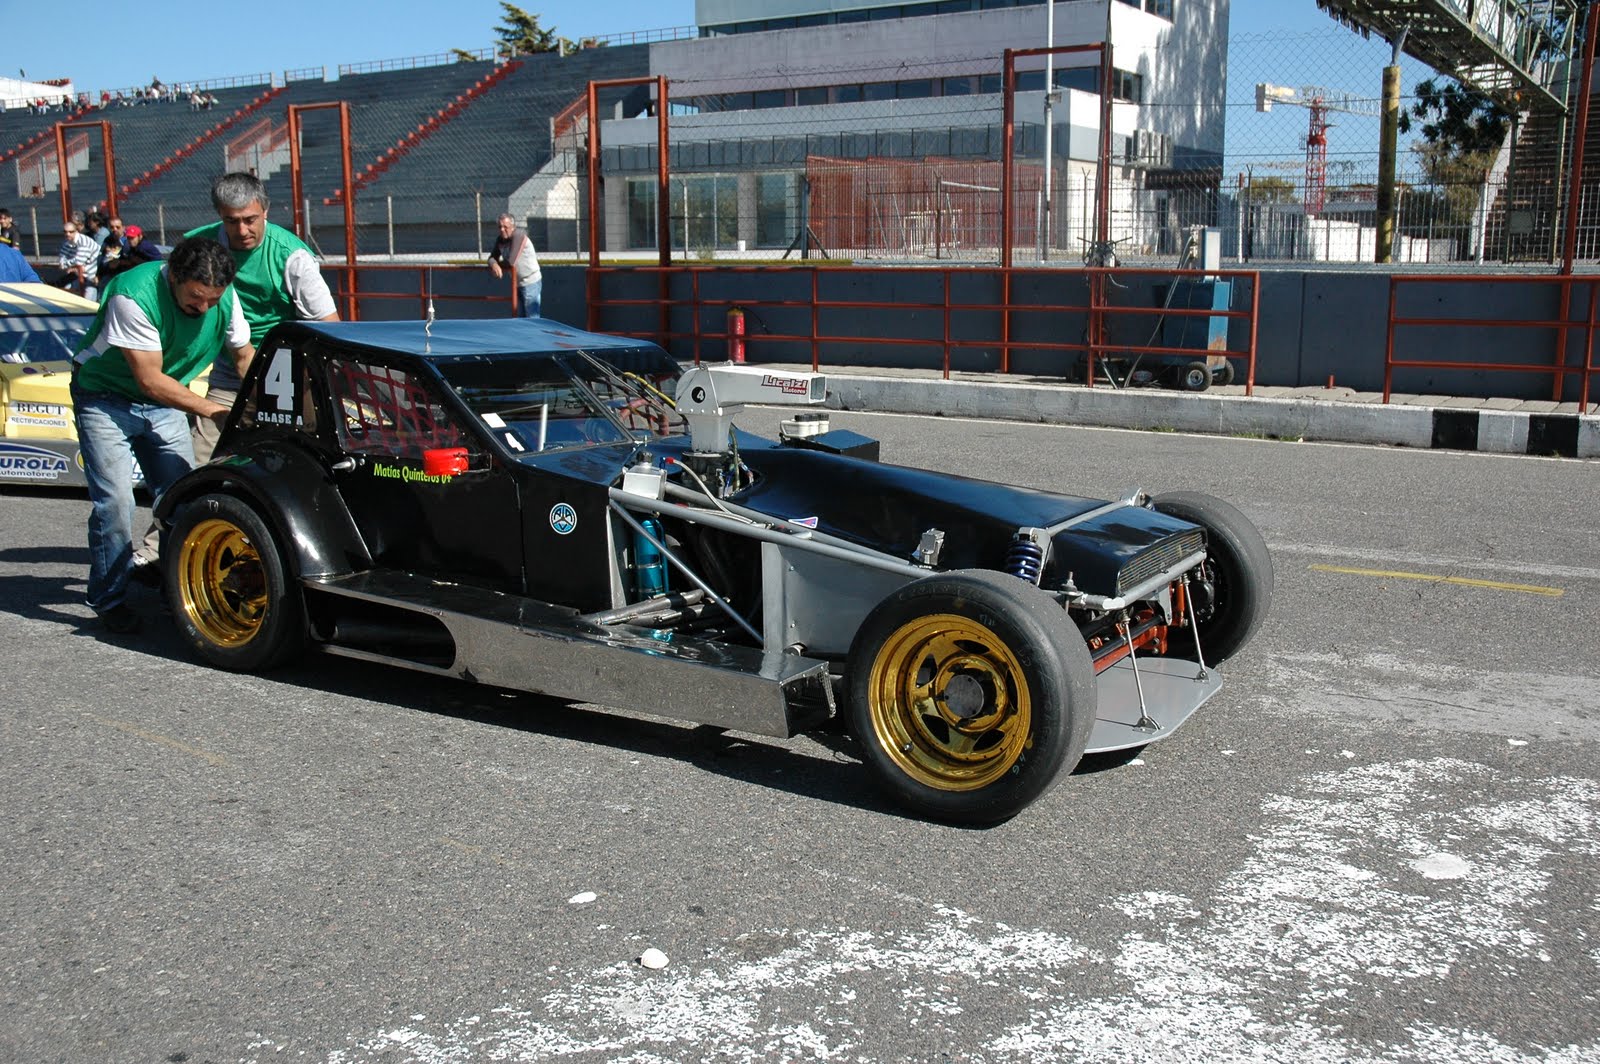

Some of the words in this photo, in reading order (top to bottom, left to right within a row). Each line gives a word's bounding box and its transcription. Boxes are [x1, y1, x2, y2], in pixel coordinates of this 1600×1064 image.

[265, 348, 294, 411] 4
[696, 390, 705, 401] 4
[17, 403, 65, 415] BEGUT
[11, 417, 67, 427] RECTIFICACIONES
[257, 411, 292, 425] CLASE
[296, 415, 304, 426] A
[0, 470, 58, 478] utomotores
